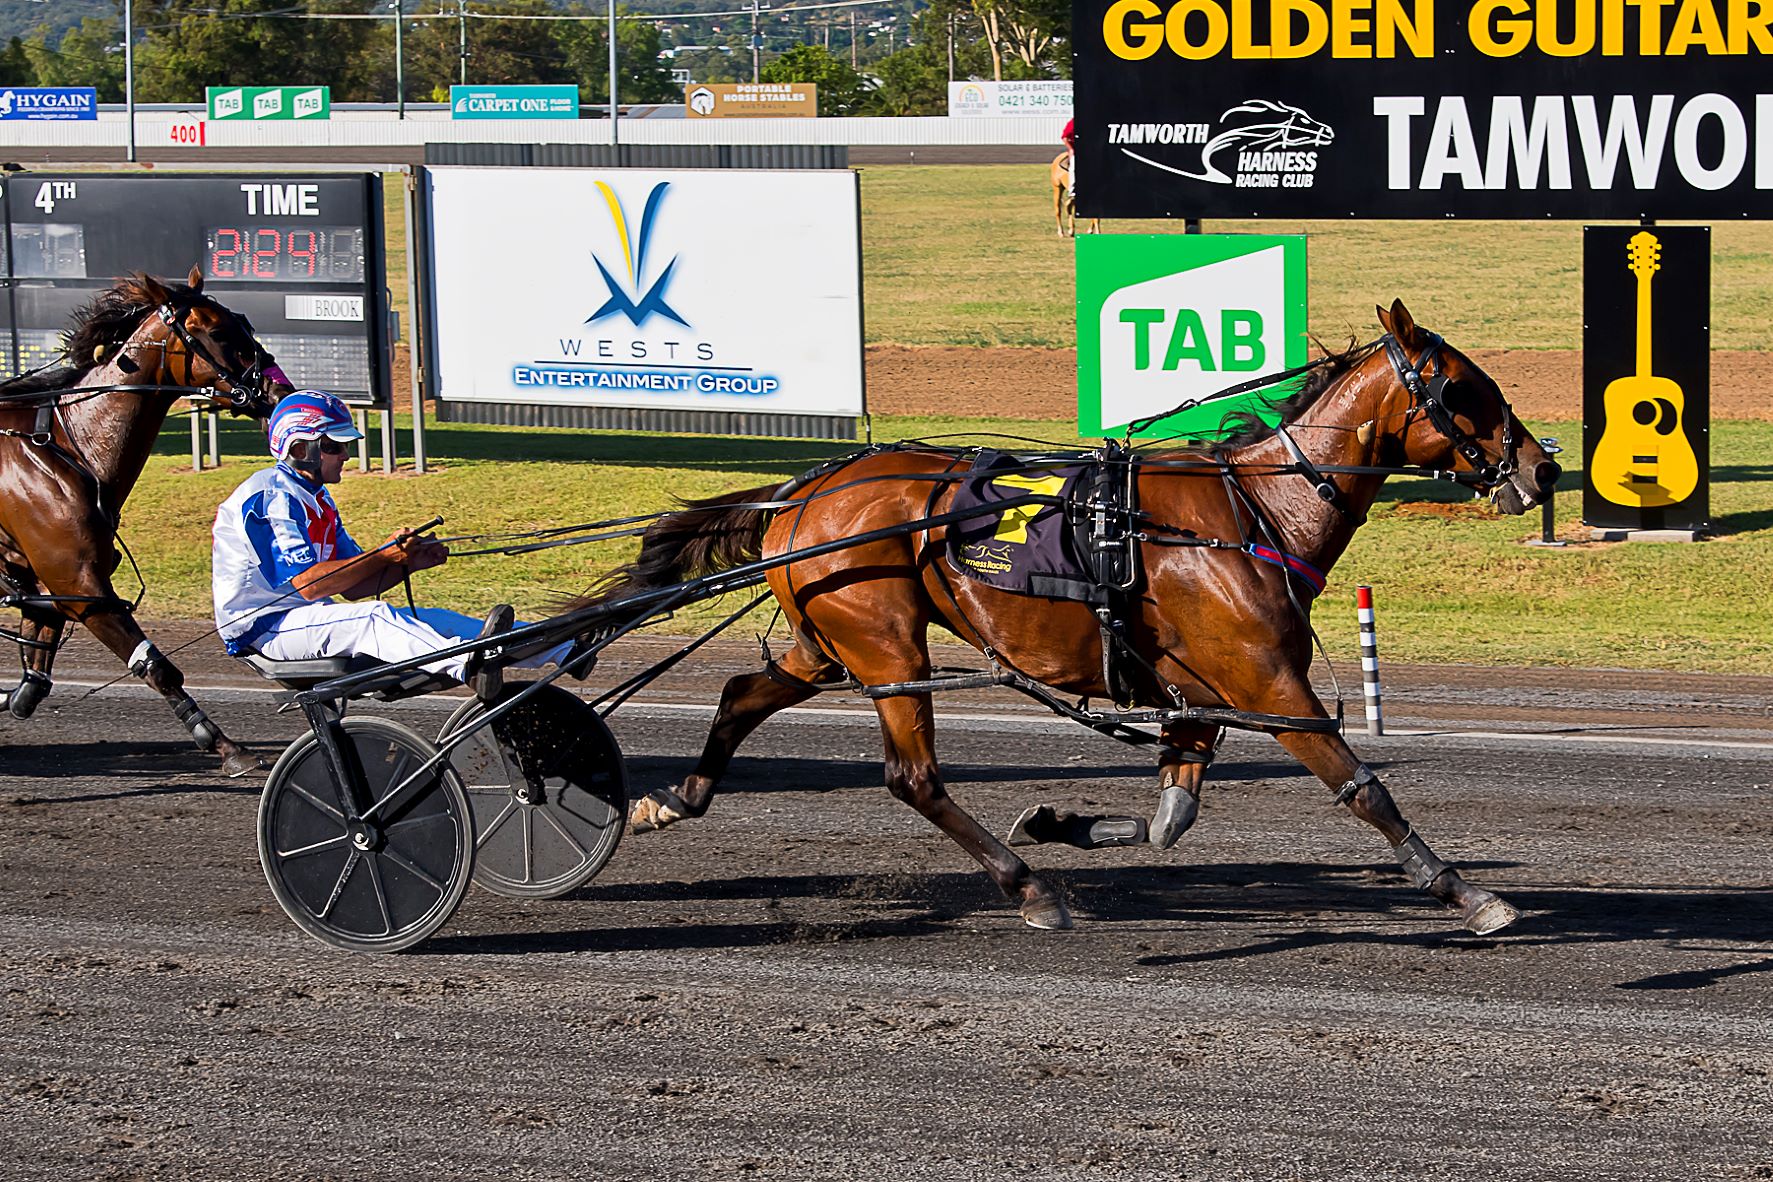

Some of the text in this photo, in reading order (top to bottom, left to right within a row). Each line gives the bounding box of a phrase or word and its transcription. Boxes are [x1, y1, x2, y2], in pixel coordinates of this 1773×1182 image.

[1102, 0, 1773, 60] GOLDEN GUITAR
[736, 85, 792, 93] PORTABLE
[998, 84, 1024, 92] SOLAR
[1033, 84, 1073, 92] BATTERIES
[16, 94, 91, 107] HYGAIN
[218, 99, 240, 109] TAB
[258, 99, 279, 109] TAB
[298, 98, 319, 109] TAB
[723, 94, 806, 102] HORSE STABLES
[999, 95, 1025, 106] 0421
[1030, 95, 1050, 106] 340
[1053, 95, 1073, 106] 750
[468, 99, 519, 112] CARPET
[520, 99, 549, 112] ONE
[171, 125, 197, 143] 400
[1108, 124, 1210, 144] TAMWORTH
[1237, 151, 1318, 172] HARNESS
[1235, 174, 1314, 188] RACING CLUB
[34, 182, 77, 214] 4TH
[240, 184, 320, 216] TIME
[315, 300, 359, 317] BROOK
[1119, 309, 1266, 372] TAB
[560, 339, 714, 361] WESTS
[514, 367, 778, 394] ENTERTAINMENT GROUP
[987, 561, 1012, 573] Racing
